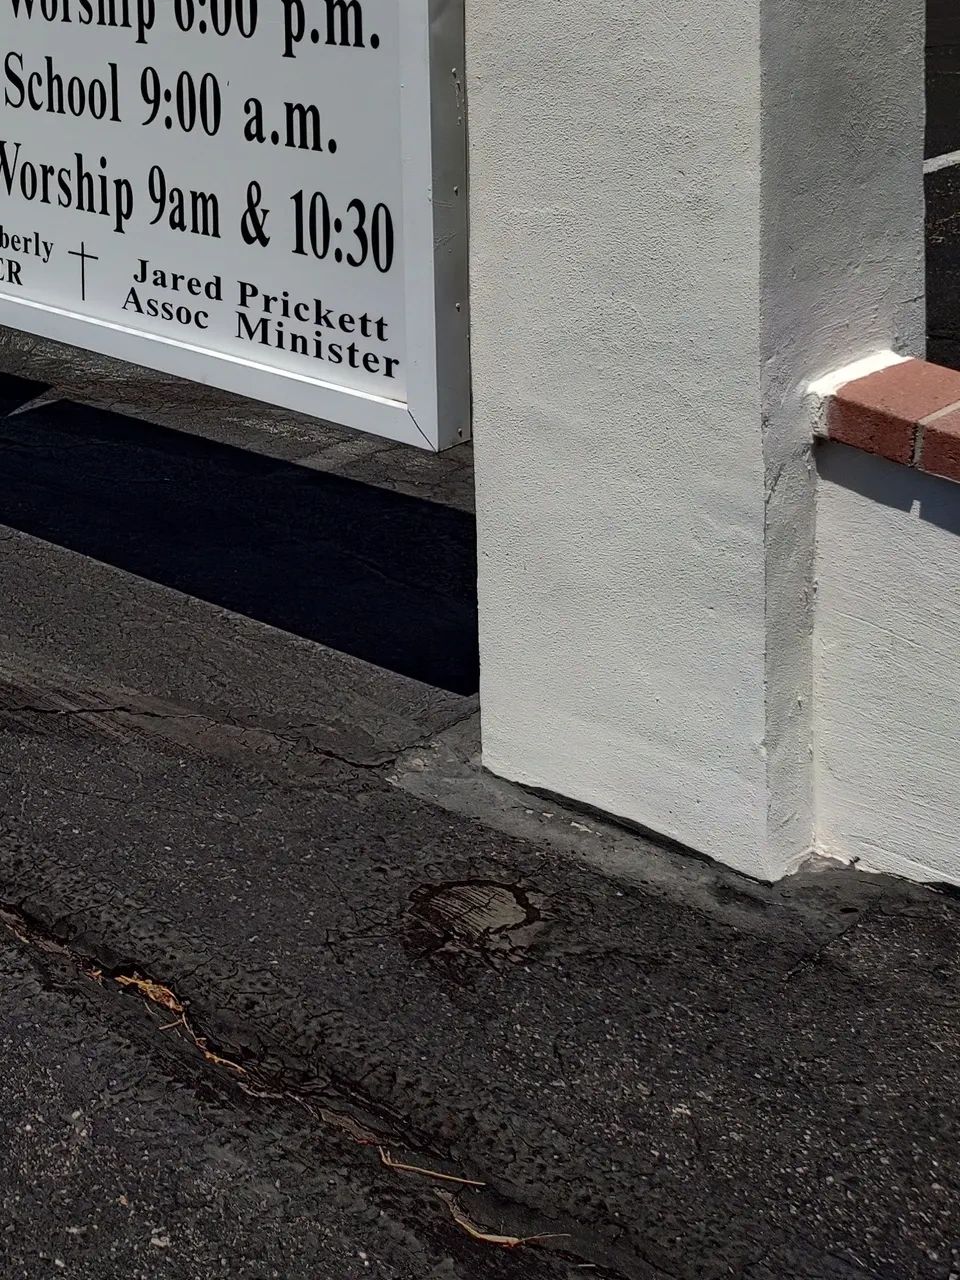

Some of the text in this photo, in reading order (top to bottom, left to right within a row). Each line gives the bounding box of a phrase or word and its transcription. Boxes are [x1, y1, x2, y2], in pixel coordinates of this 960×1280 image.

[4, 51, 122, 123] School
[140, 66, 222, 137] 9:00
[243, 97, 338, 154] a.m.
[148, 165, 221, 239] 9am
[240, 180, 271, 248] &
[289, 189, 395, 274] 10:30
[121, 286, 400, 379] Assoc Minister
[132, 258, 389, 342] Jared Prickett
